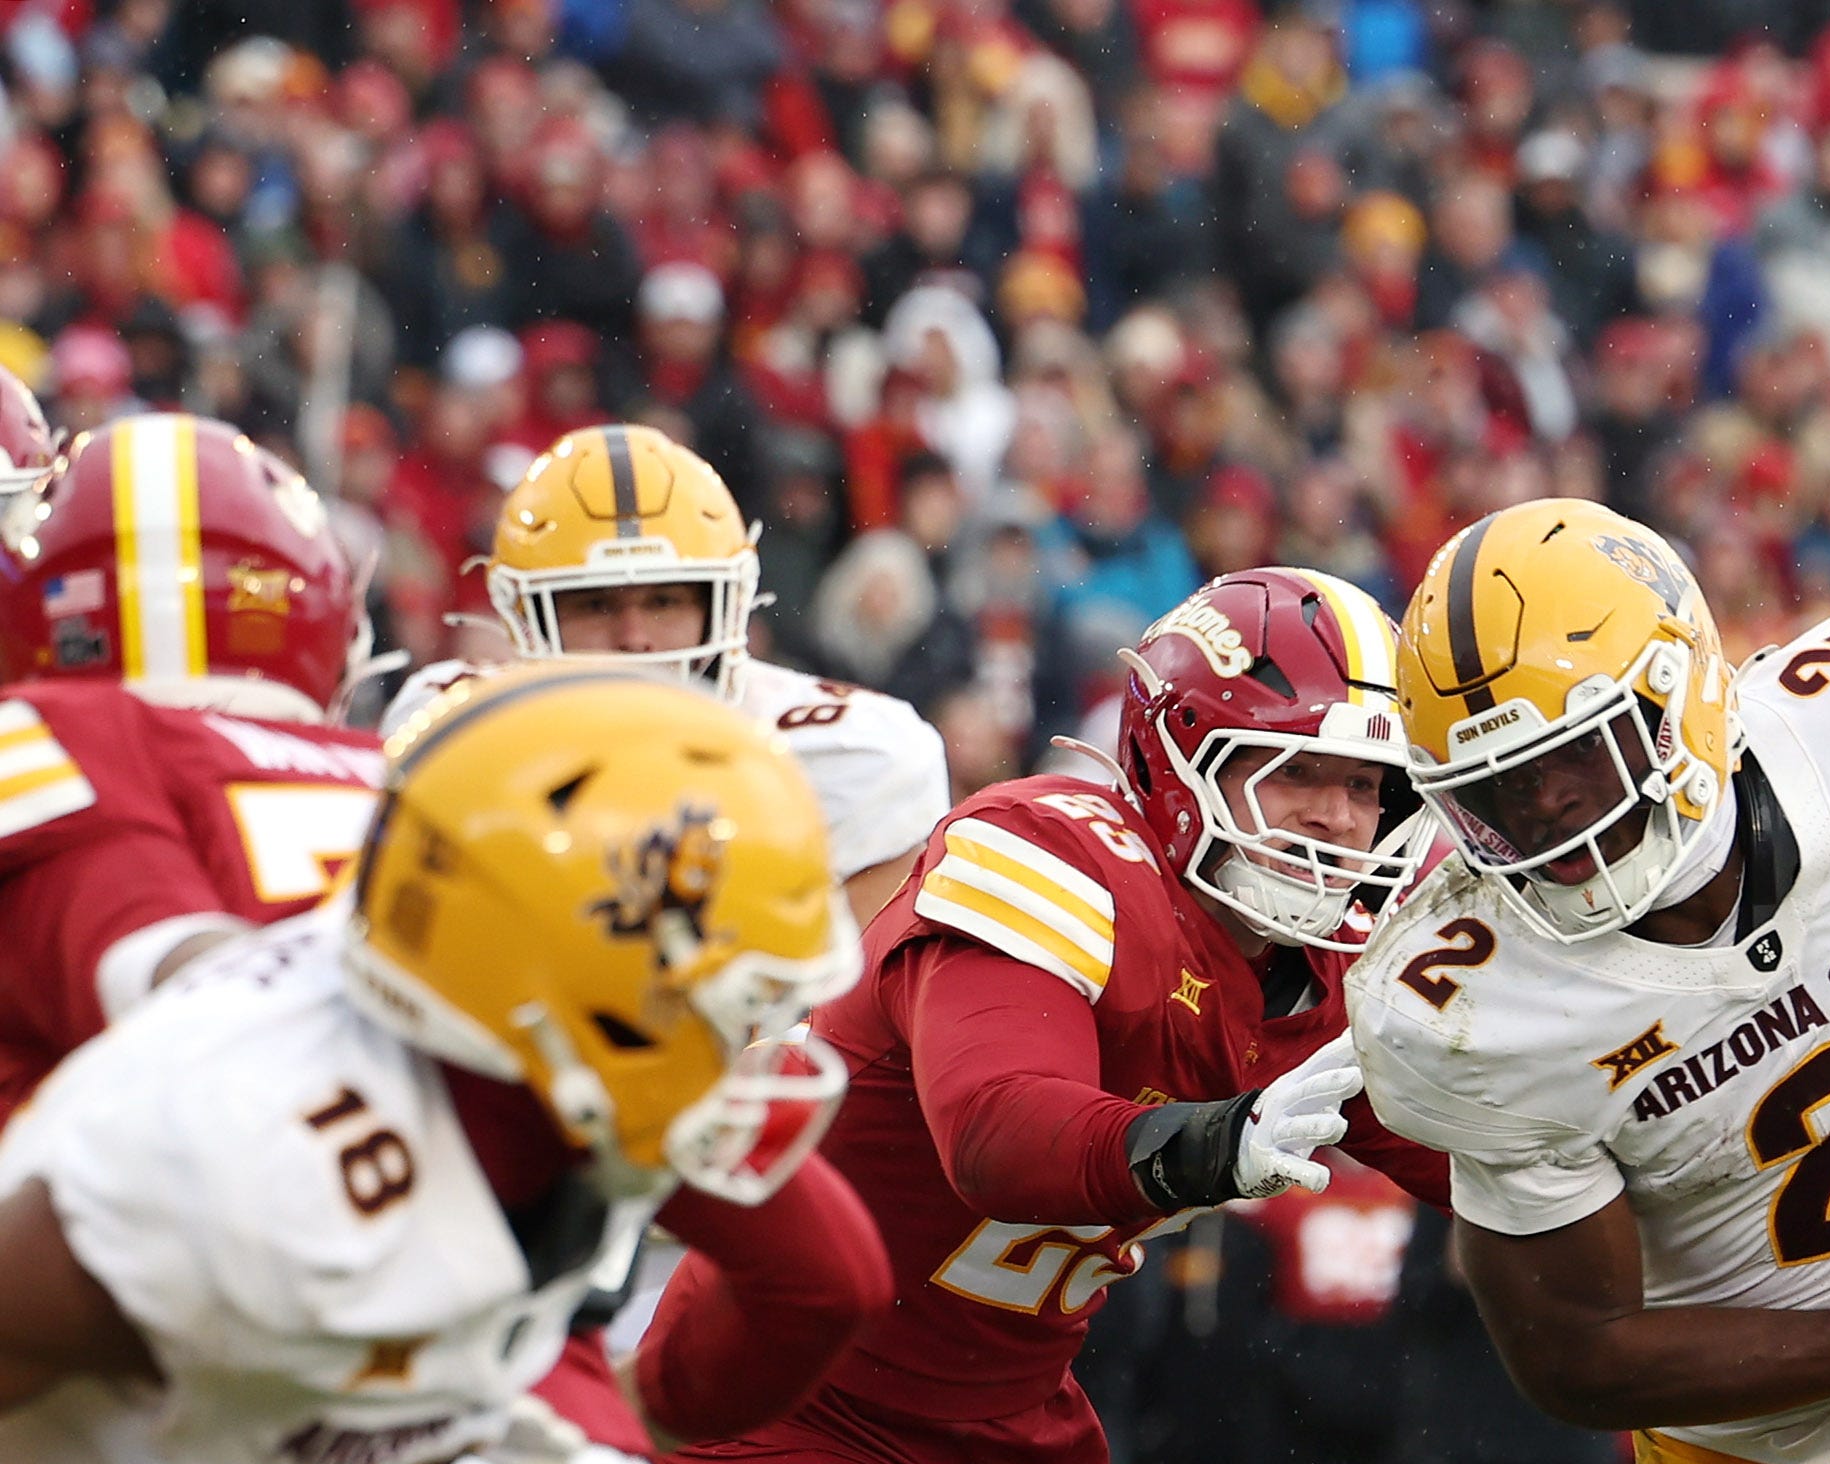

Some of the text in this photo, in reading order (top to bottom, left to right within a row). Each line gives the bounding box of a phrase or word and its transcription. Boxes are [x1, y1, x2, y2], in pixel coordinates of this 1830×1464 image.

[1455, 708, 1520, 745] SUN DEVILS
[1397, 917, 1498, 1012] 2
[1633, 984, 1830, 1122] ARIZONA
[300, 1085, 418, 1226] 18
